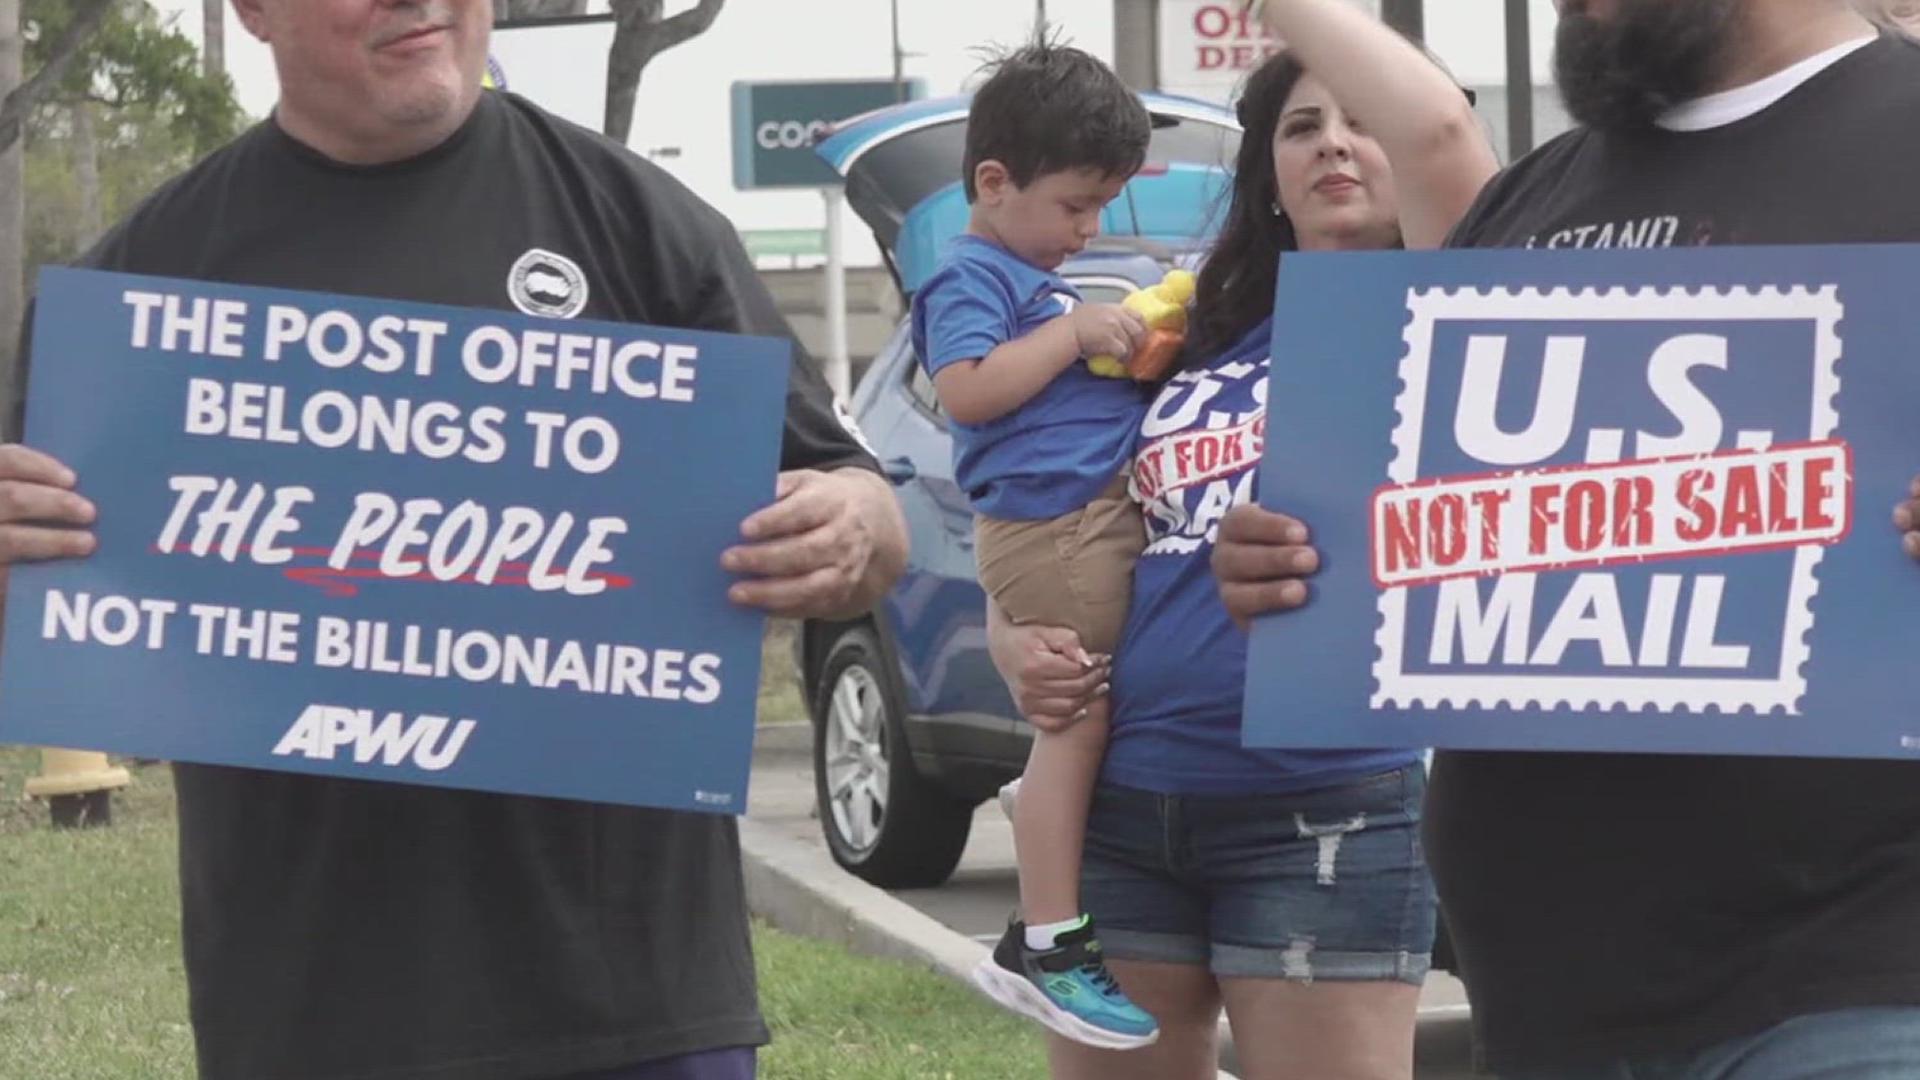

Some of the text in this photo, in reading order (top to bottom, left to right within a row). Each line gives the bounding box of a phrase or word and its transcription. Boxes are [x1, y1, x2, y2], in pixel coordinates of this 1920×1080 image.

[123, 291, 698, 402] THE POST OFFICE
[1454, 333, 1775, 466] U.S.
[185, 377, 620, 475] BELONGS TO
[157, 475, 628, 596] THE PEOPLE
[1383, 456, 1836, 573] NOT FOR SALE
[42, 588, 722, 704] NOT THE BILLIONAIRES
[1428, 572, 1751, 668] MAIL
[272, 703, 477, 771] APWU
